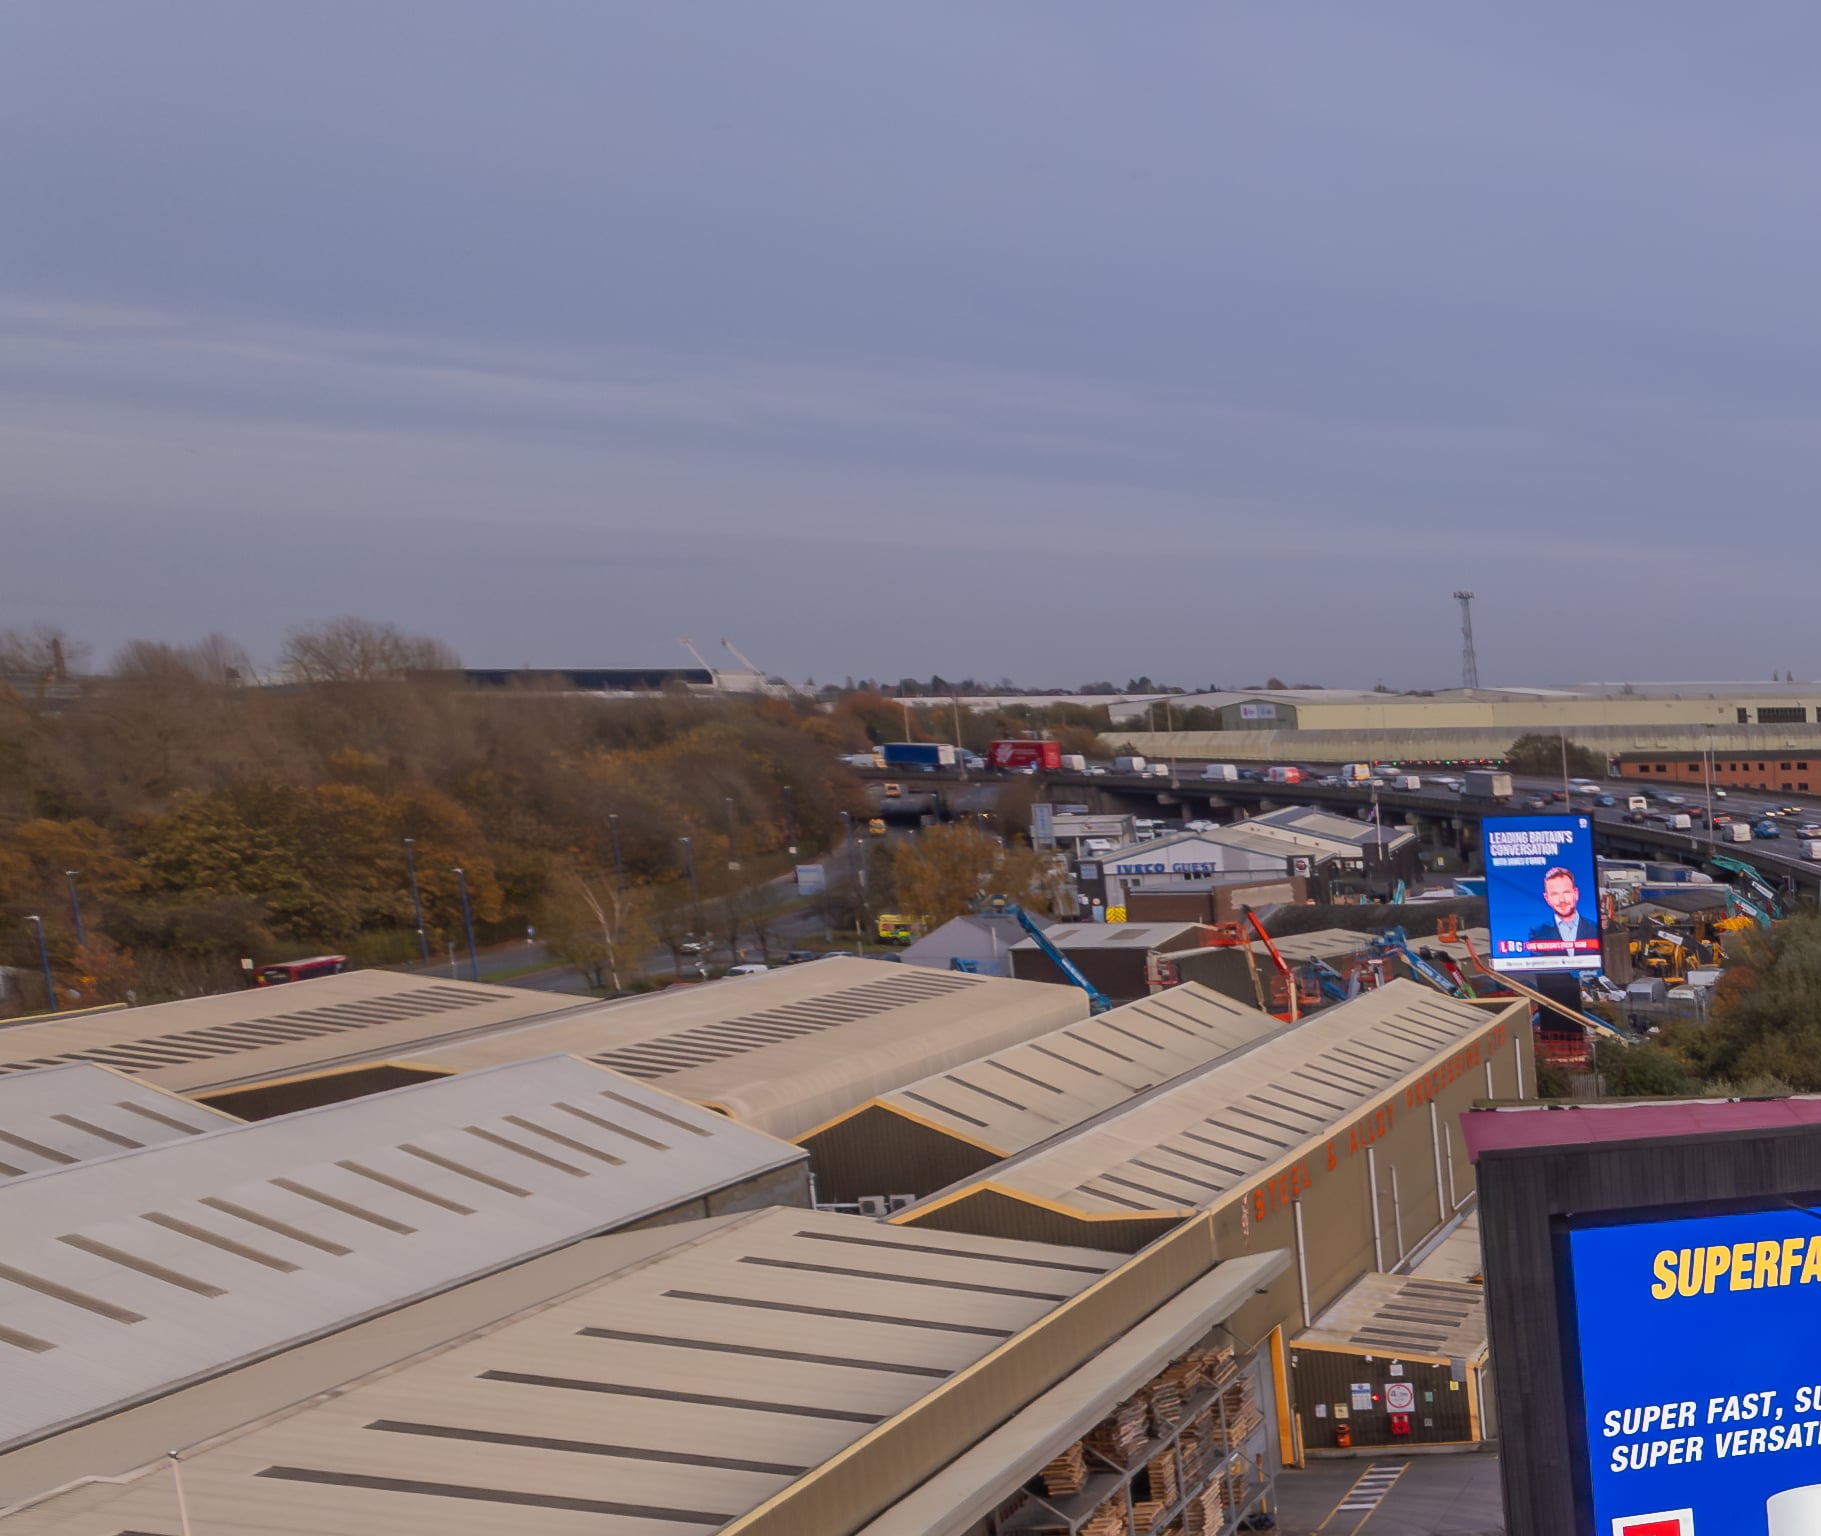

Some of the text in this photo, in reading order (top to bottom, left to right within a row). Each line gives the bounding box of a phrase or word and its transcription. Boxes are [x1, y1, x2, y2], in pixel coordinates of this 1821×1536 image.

[1489, 831, 1528, 845] LEADING
[1490, 843, 1559, 856] CONVERSATION
[1116, 862, 1217, 874] IVECO GUEST
[1500, 940, 1523, 953] LBC
[1253, 1159, 1312, 1223] STEEL
[1349, 1100, 1394, 1158] ALLOY
[1405, 1040, 1482, 1114] PROCESSING
[1602, 1401, 1697, 1437] SUPER
[1707, 1390, 1784, 1423] FAST,
[1610, 1436, 1704, 1473] SUPER
